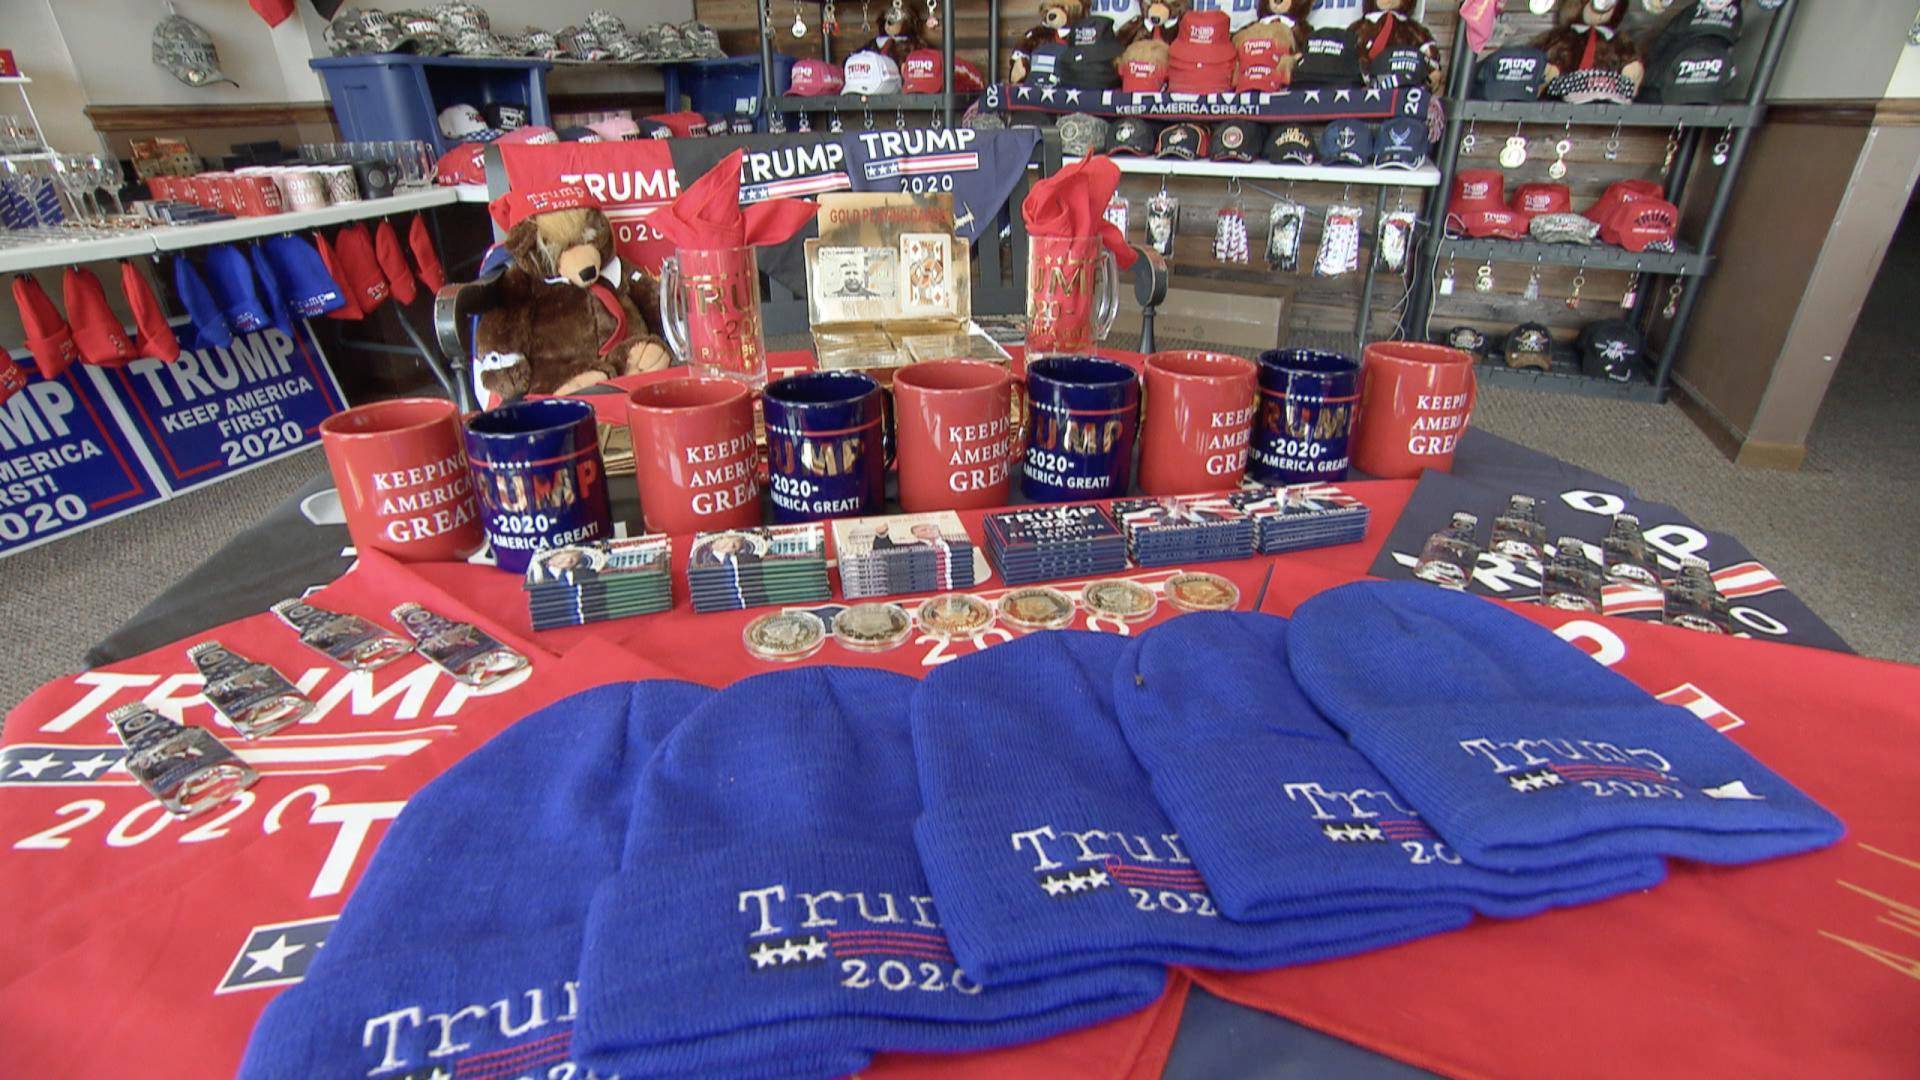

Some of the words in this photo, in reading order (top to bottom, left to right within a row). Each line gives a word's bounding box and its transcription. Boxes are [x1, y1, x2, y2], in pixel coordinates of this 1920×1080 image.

[1116, 104, 1146, 115] KEEP
[1151, 102, 1209, 114] AMERICA
[1210, 104, 1260, 115] GREAT!
[859, 128, 976, 160] TRUMP
[526, 185, 586, 206] Trump
[901, 174, 954, 194] 2020
[551, 199, 579, 209] 2020
[830, 207, 861, 225] GOLD
[128, 328, 294, 408] TRUMP
[161, 402, 221, 434] KEEP
[224, 376, 314, 416] AMERICA
[217, 404, 285, 438] FIRST!
[220, 421, 304, 467] 2020
[686, 430, 755, 465] KEEPIN
[0, 439, 103, 484] MERICA
[373, 452, 468, 491] KEEPING
[949, 459, 1009, 493] GREA
[1205, 448, 1249, 476] GRE
[1261, 452, 1315, 473] AMERICA
[382, 475, 472, 515] AMERICA
[477, 459, 598, 513] RUMP
[691, 478, 757, 515] GREA
[1066, 475, 1110, 490] GREAT!
[0, 494, 88, 546] 020
[386, 496, 477, 543] GREAT
[813, 497, 859, 513] GREAT!
[997, 505, 1097, 525] TRUMP
[1273, 510, 1321, 523] DONALD
[1321, 506, 1359, 518] TRUMP
[552, 520, 599, 547] GREAT!
[1149, 521, 1201, 533] DONALD
[1201, 518, 1242, 530] TRUMP
[1459, 737, 1680, 780] Trump
[1011, 824, 1191, 872] Tru
[1401, 840, 1463, 865] 20
[738, 884, 942, 937] Tru
[1128, 887, 1218, 917] 202
[363, 980, 580, 1077] Tru
